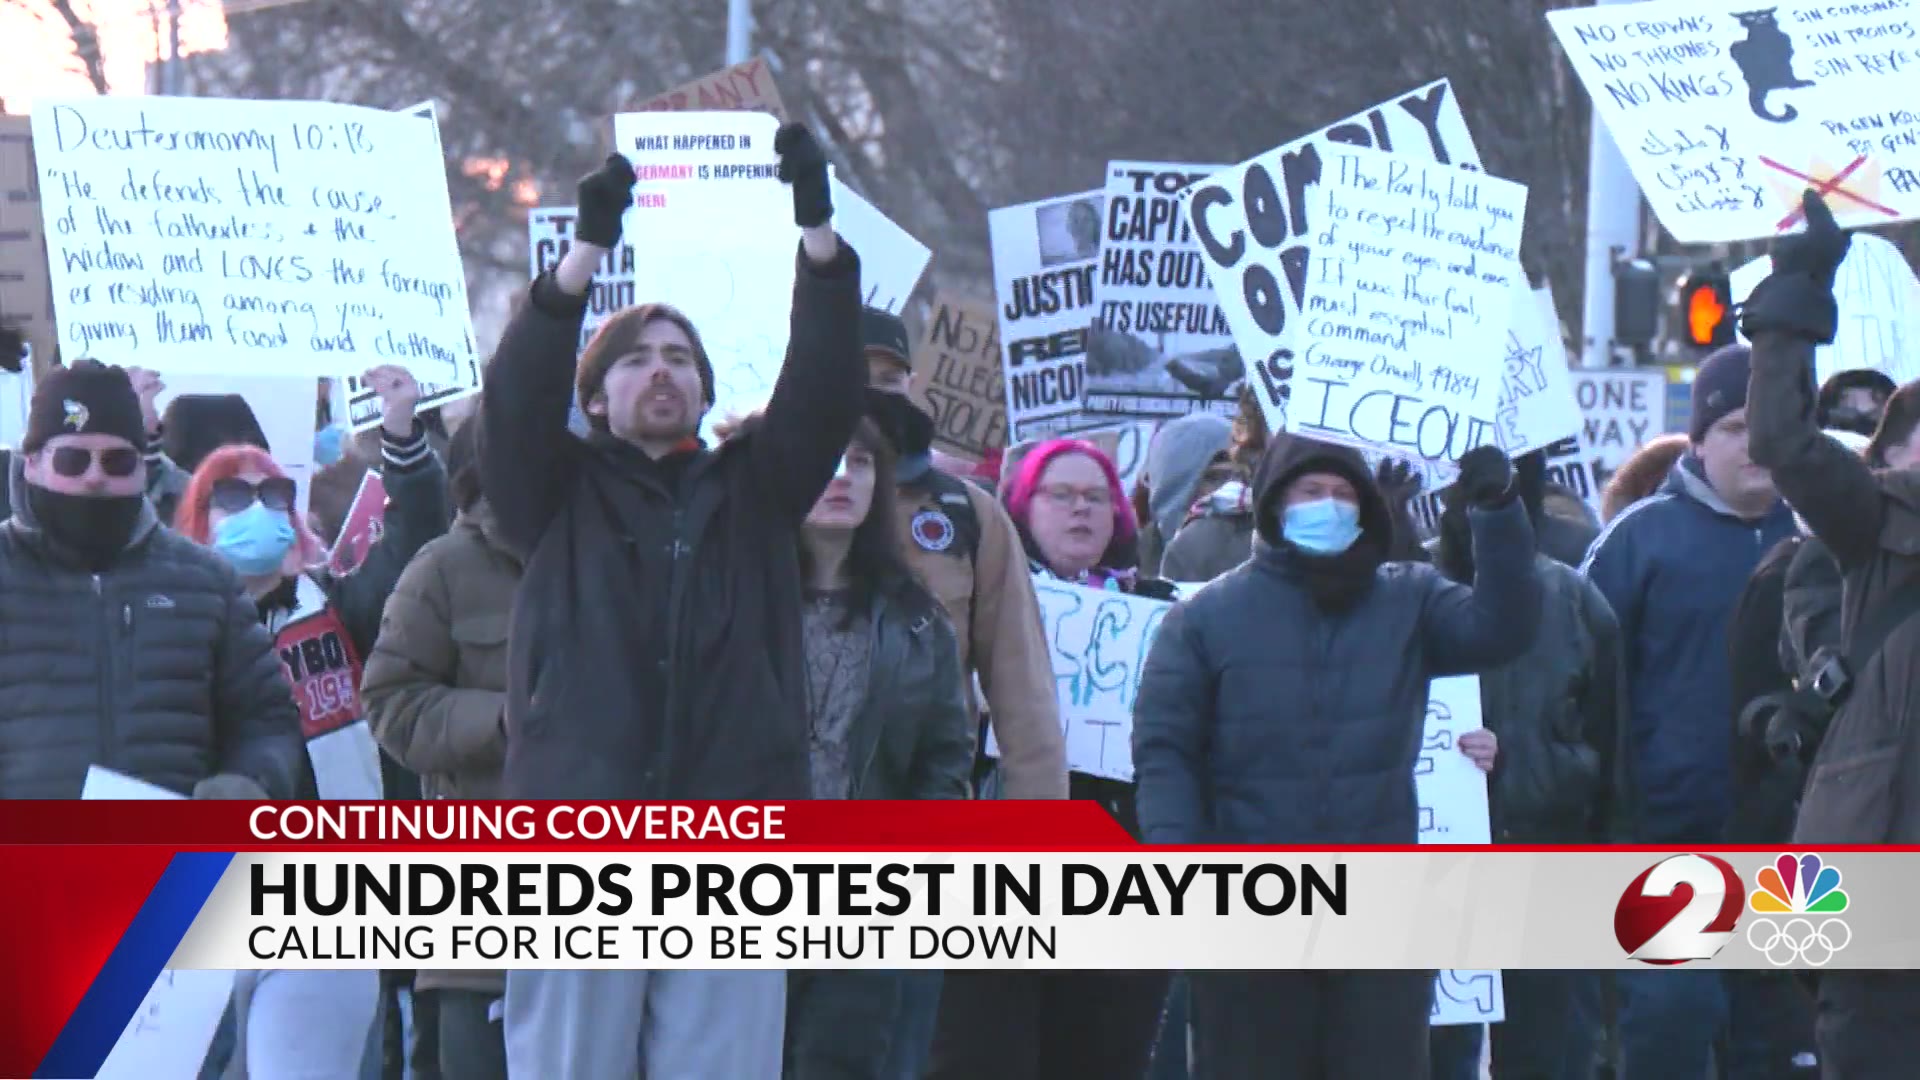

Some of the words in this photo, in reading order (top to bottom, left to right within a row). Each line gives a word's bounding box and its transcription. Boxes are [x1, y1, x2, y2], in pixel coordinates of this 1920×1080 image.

[1574, 24, 1616, 46] NO
[1624, 15, 1713, 39] CROWNS
[1792, 8, 1823, 23] SIN
[1827, 0, 1908, 17] CORONA
[1806, 30, 1841, 48] SIN
[1844, 21, 1915, 44] TRONOS
[1590, 52, 1627, 72] NO
[1632, 40, 1720, 67] THRONES
[1814, 57, 1852, 77] SIN
[1604, 78, 1650, 110] NO
[1649, 70, 1733, 104] KINGS
[53, 104, 278, 174] Deuteronomy
[635, 134, 669, 150] WHAT
[673, 133, 735, 150] HAPPENED
[739, 135, 751, 149] IN
[636, 164, 694, 180] GERMANY
[698, 164, 709, 179] IS
[121, 167, 222, 203] defends
[237, 167, 290, 207] the
[312, 186, 397, 221] cause
[637, 194, 667, 208] HERE
[1336, 155, 1380, 190] The
[1387, 160, 1440, 214] Party
[1448, 175, 1478, 211] told
[1486, 203, 1513, 230] you
[57, 205, 76, 235] of
[96, 205, 132, 235] the
[332, 217, 376, 243] the
[1108, 195, 1190, 242] CAPI
[1328, 189, 1348, 219] to
[1357, 207, 1416, 236] reject
[1421, 211, 1445, 240] the
[163, 247, 203, 275] and
[222, 250, 312, 282] LOVES
[330, 257, 366, 286] the
[1101, 248, 1153, 288] HAS
[1156, 248, 1213, 290] OUT
[1318, 222, 1338, 246] of
[1348, 240, 1394, 264] your
[1401, 251, 1441, 276] eyes
[1447, 252, 1477, 279] and
[1317, 257, 1345, 287] It
[1356, 278, 1395, 297] was
[108, 277, 204, 324] residing
[223, 293, 319, 334] among
[1101, 299, 1132, 332] ITS
[1135, 301, 1232, 336] USEFULN
[1308, 291, 1357, 317] most
[69, 320, 138, 353] giving
[156, 309, 213, 345] them
[226, 314, 289, 348] food
[310, 328, 356, 353] and
[1307, 317, 1407, 352] command
[1305, 341, 1366, 380] George
[1576, 379, 1648, 411] ONE
